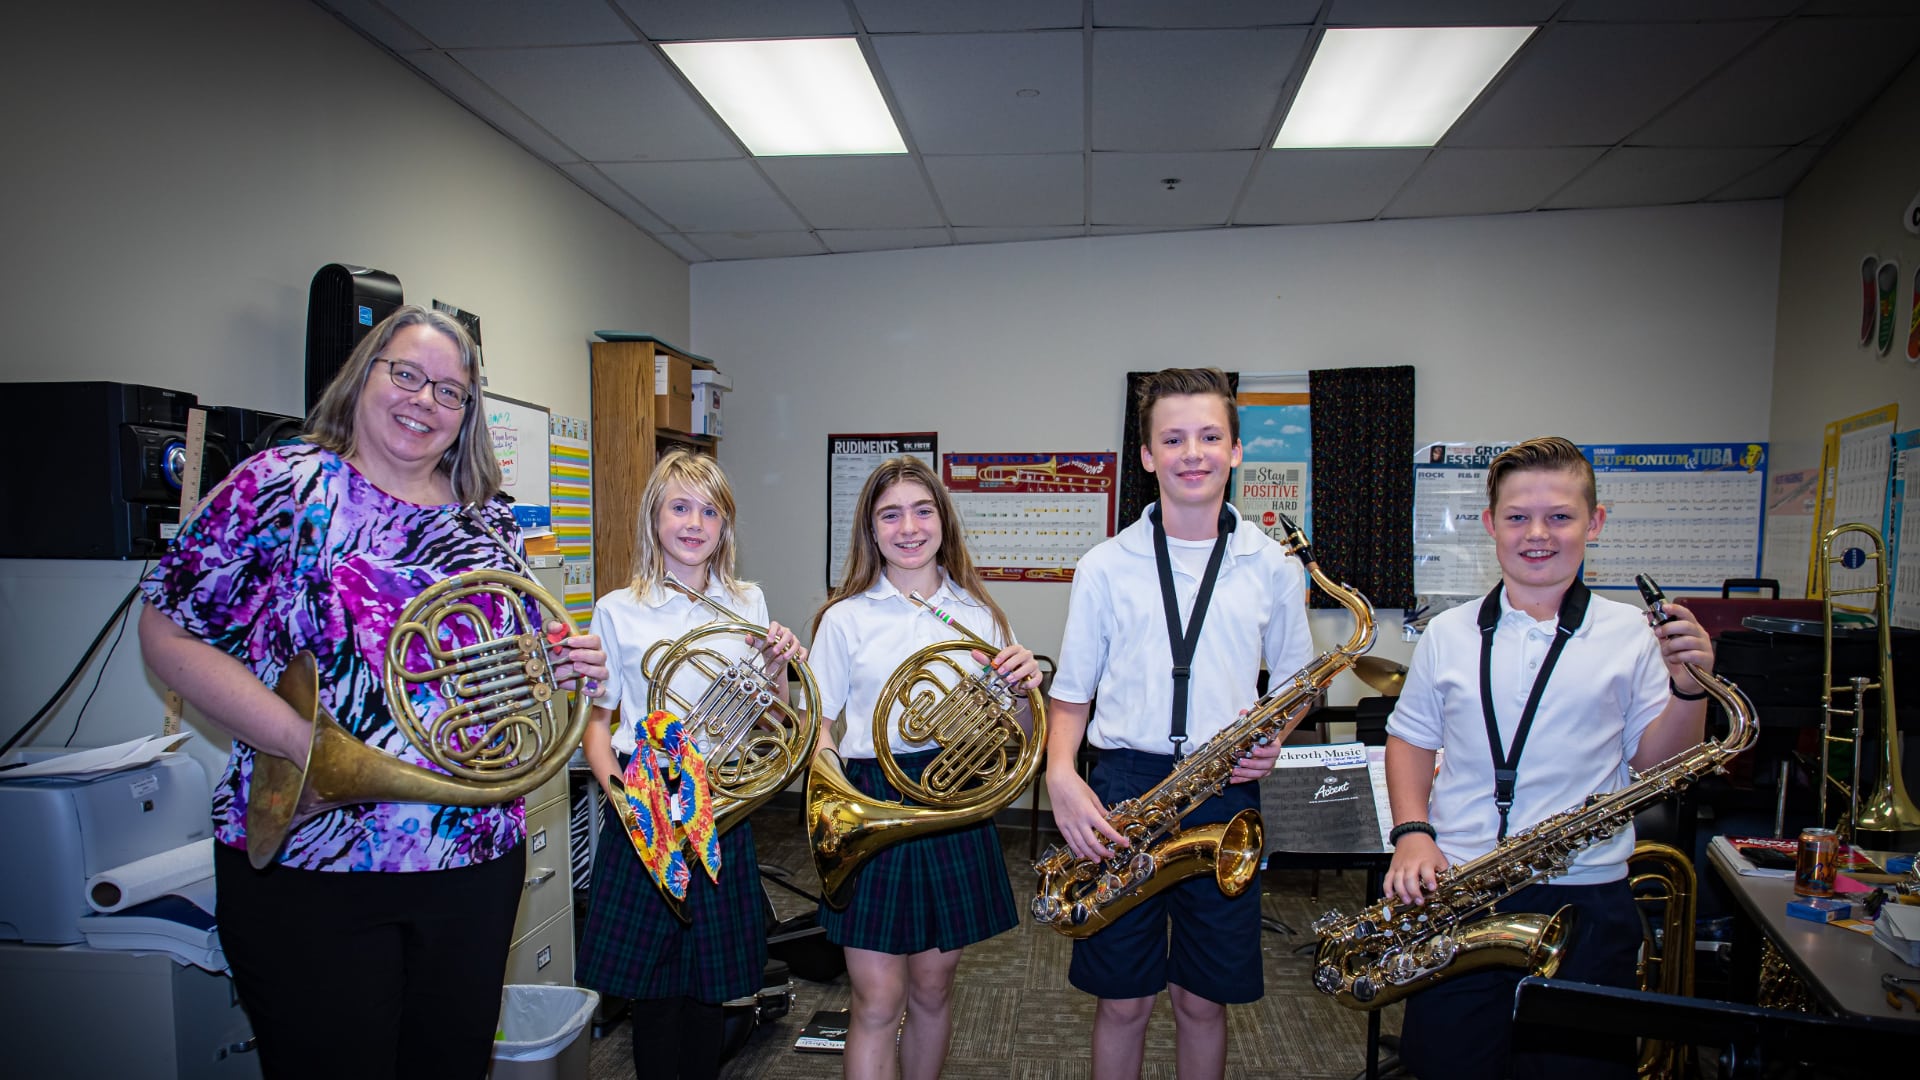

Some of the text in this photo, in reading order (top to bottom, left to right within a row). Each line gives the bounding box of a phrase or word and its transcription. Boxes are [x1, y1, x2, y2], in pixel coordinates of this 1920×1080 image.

[834, 440, 899, 454] RUDIMENTS
[1446, 455, 1495, 464] ESSEN
[1593, 454, 1689, 466] EUPHONIUM
[1684, 457, 1697, 470] &
[1692, 448, 1733, 465] TUBA
[1257, 467, 1285, 485] Stay
[1243, 485, 1299, 498] POSITIVE
[1272, 500, 1297, 510] HARD
[1324, 748, 1361, 758] Music
[1314, 781, 1350, 800] Accent
